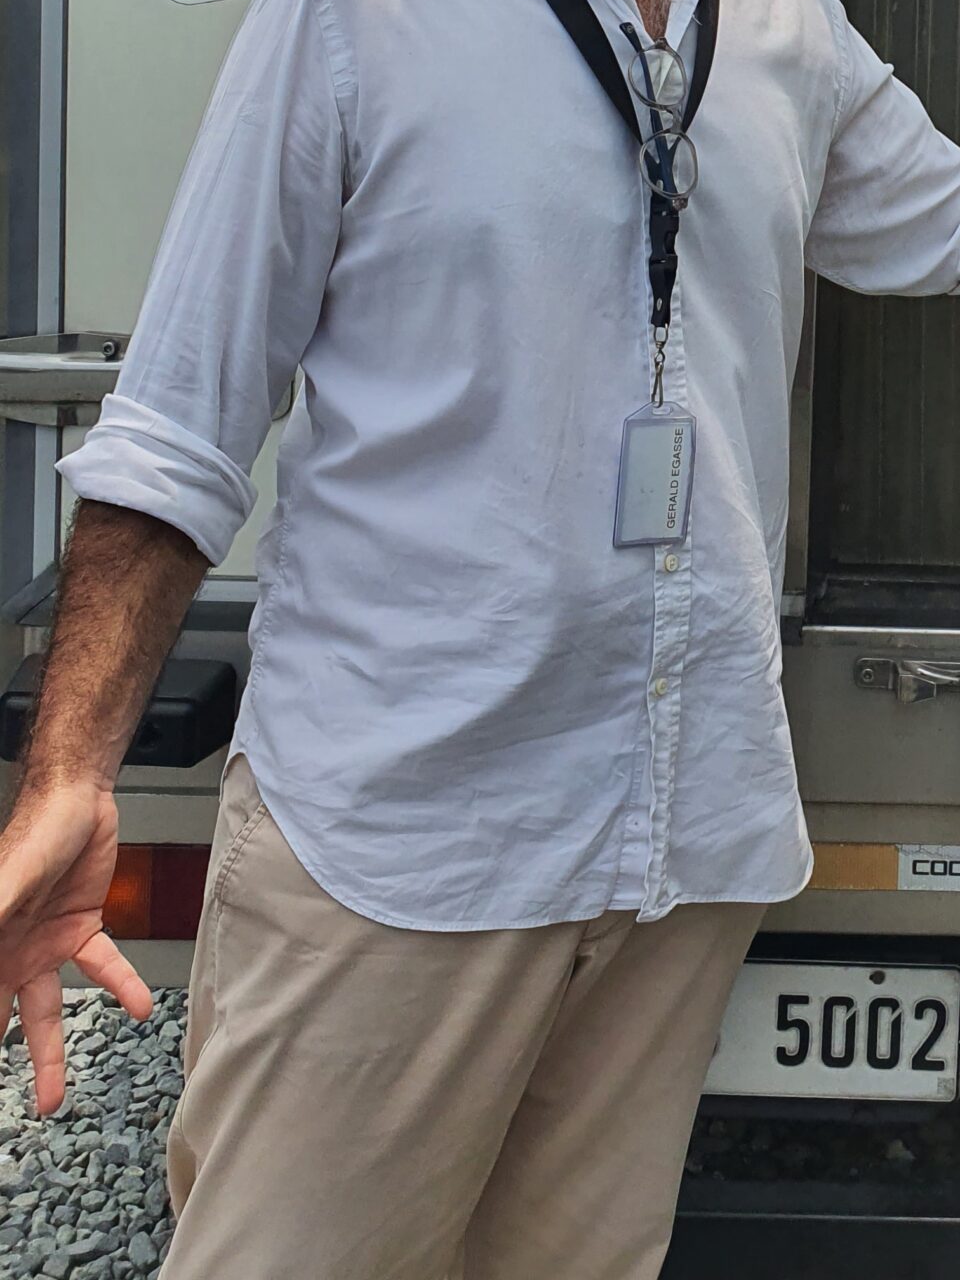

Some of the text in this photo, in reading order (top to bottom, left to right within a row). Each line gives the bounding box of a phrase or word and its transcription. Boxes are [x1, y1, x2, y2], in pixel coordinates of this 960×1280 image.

[666, 427, 684, 529] GERALD EGASSE
[776, 994, 947, 1070] 5002
